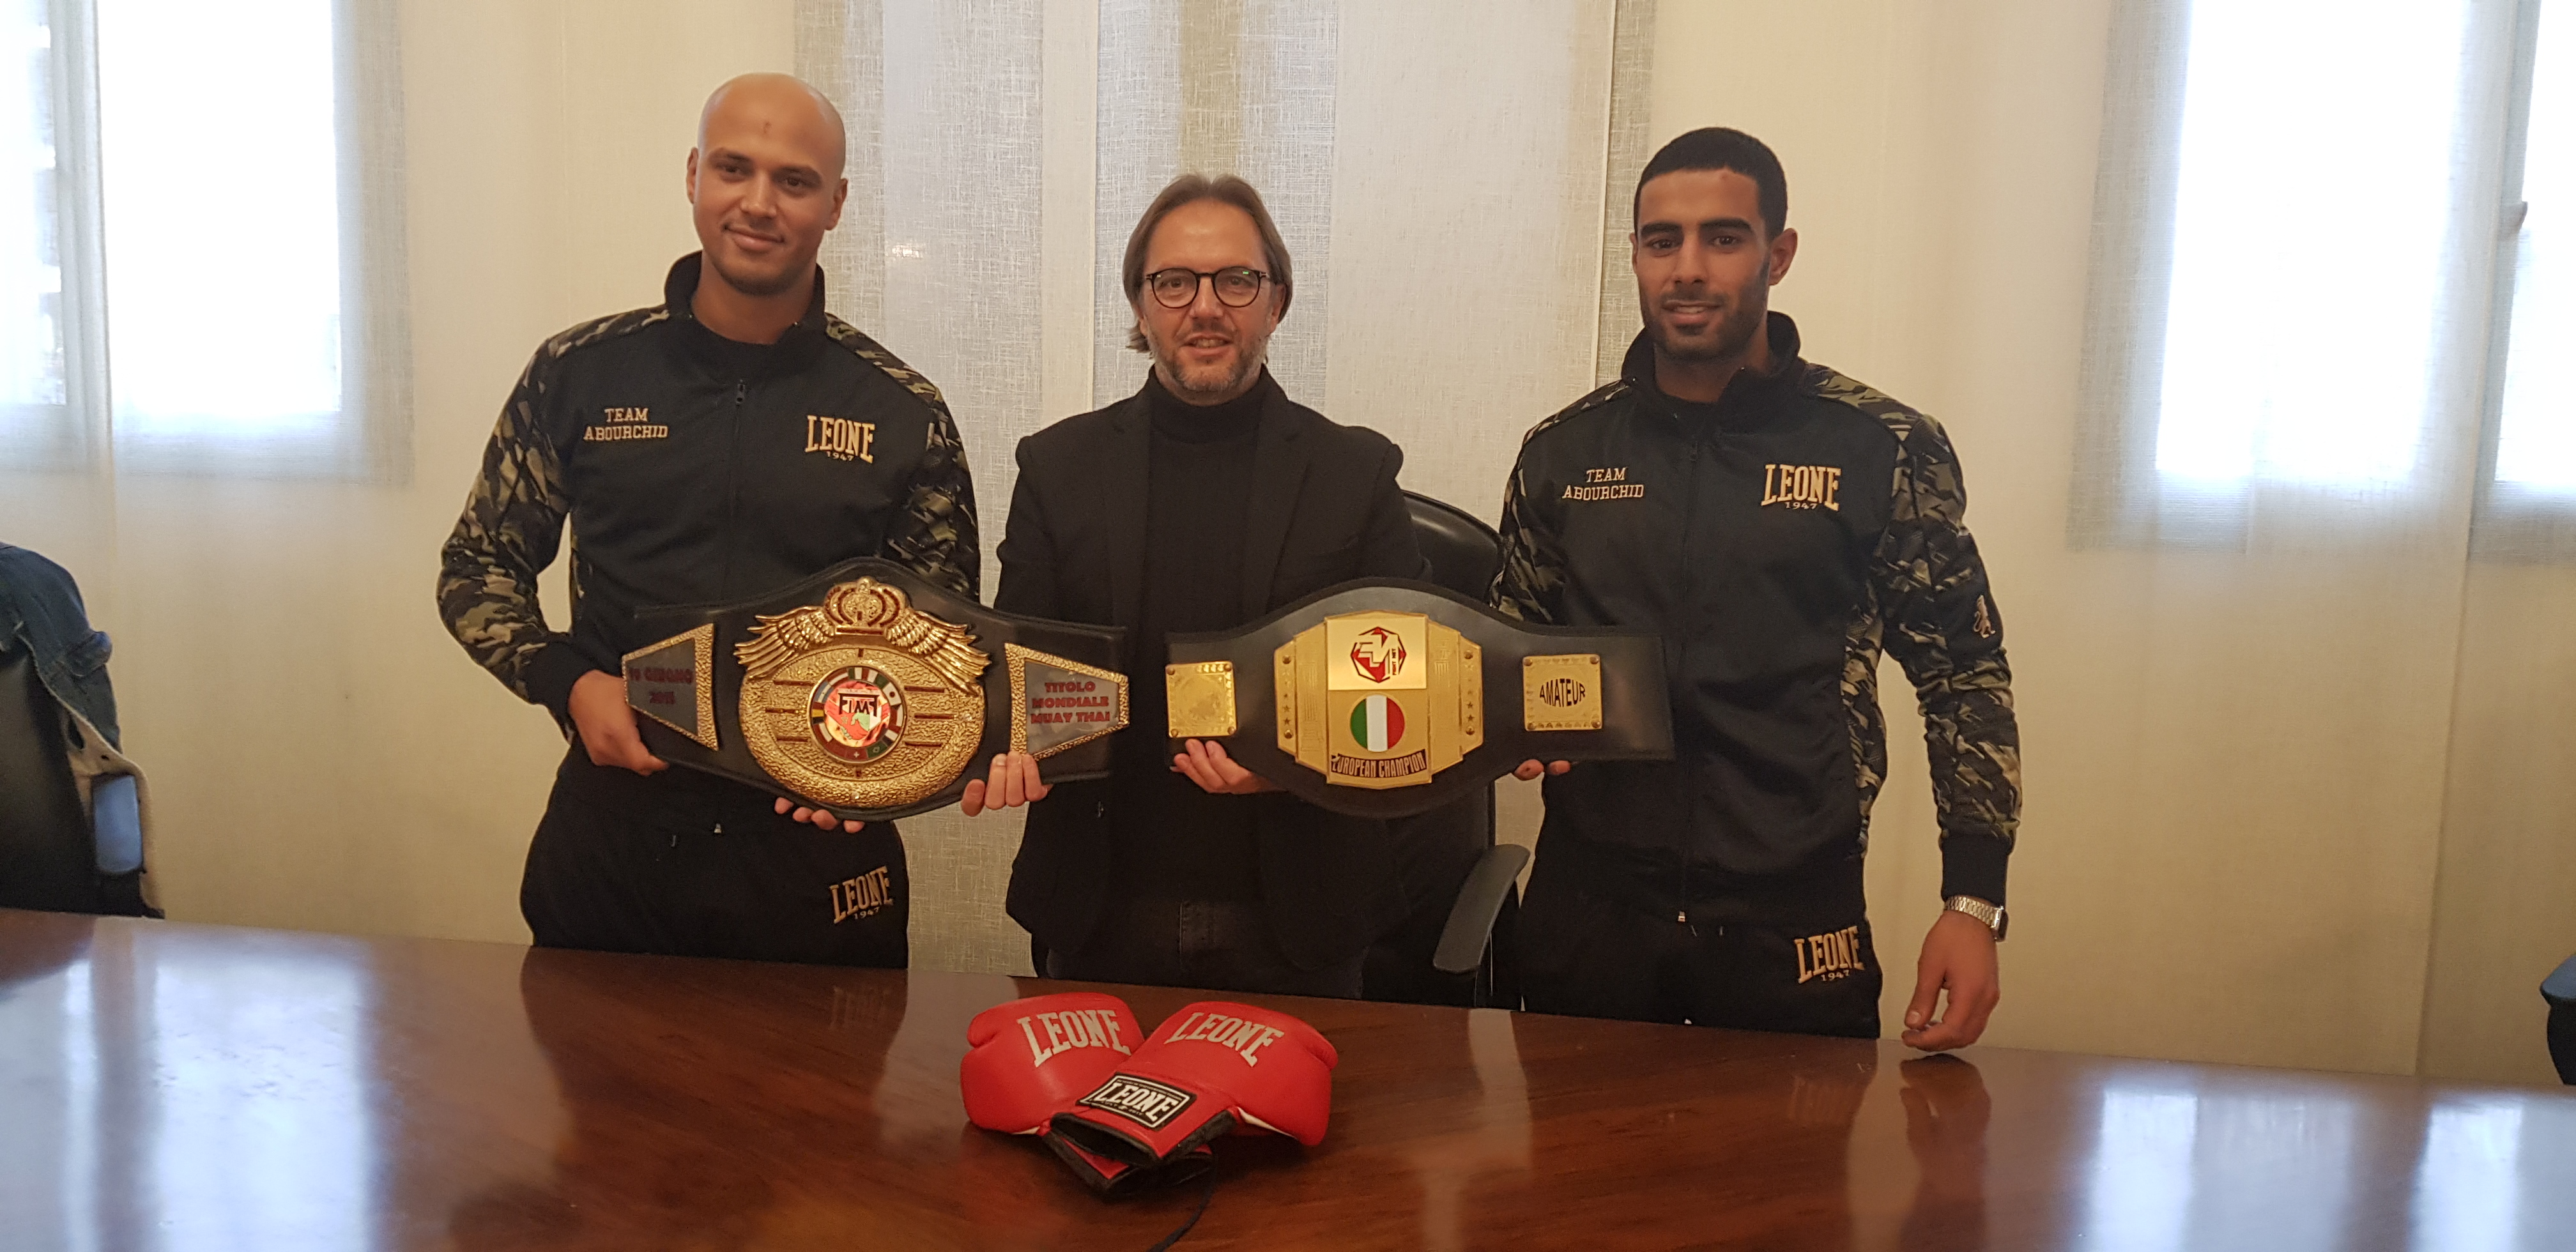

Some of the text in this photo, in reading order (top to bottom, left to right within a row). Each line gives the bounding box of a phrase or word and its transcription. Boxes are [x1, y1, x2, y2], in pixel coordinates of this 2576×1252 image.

[604, 407, 649, 422] TEAM
[583, 425, 669, 441] ABOURCHID
[804, 415, 875, 464] LEONE
[826, 450, 855, 461] 1947
[1586, 467, 1627, 483] TEAM
[1561, 484, 1644, 501] ABOURCHID
[1761, 464, 1841, 511] LEONE
[1785, 501, 1818, 510] 1947
[1045, 681, 1096, 692] TITOLO
[1539, 678, 1586, 707] AMATEUR
[1032, 696, 1109, 708] MONDIALE
[1031, 712, 1110, 724] MUAY THAI
[1331, 751, 1426, 778] EUROPEAN CHAMPION
[829, 866, 894, 924] LEONE
[1793, 926, 1864, 984] LEONE
[1821, 970, 1850, 981] 1947
[1017, 1009, 1131, 1067] LEONE
[1164, 1012, 1285, 1067] LEONE
[1093, 1082, 1179, 1122] LEONE
